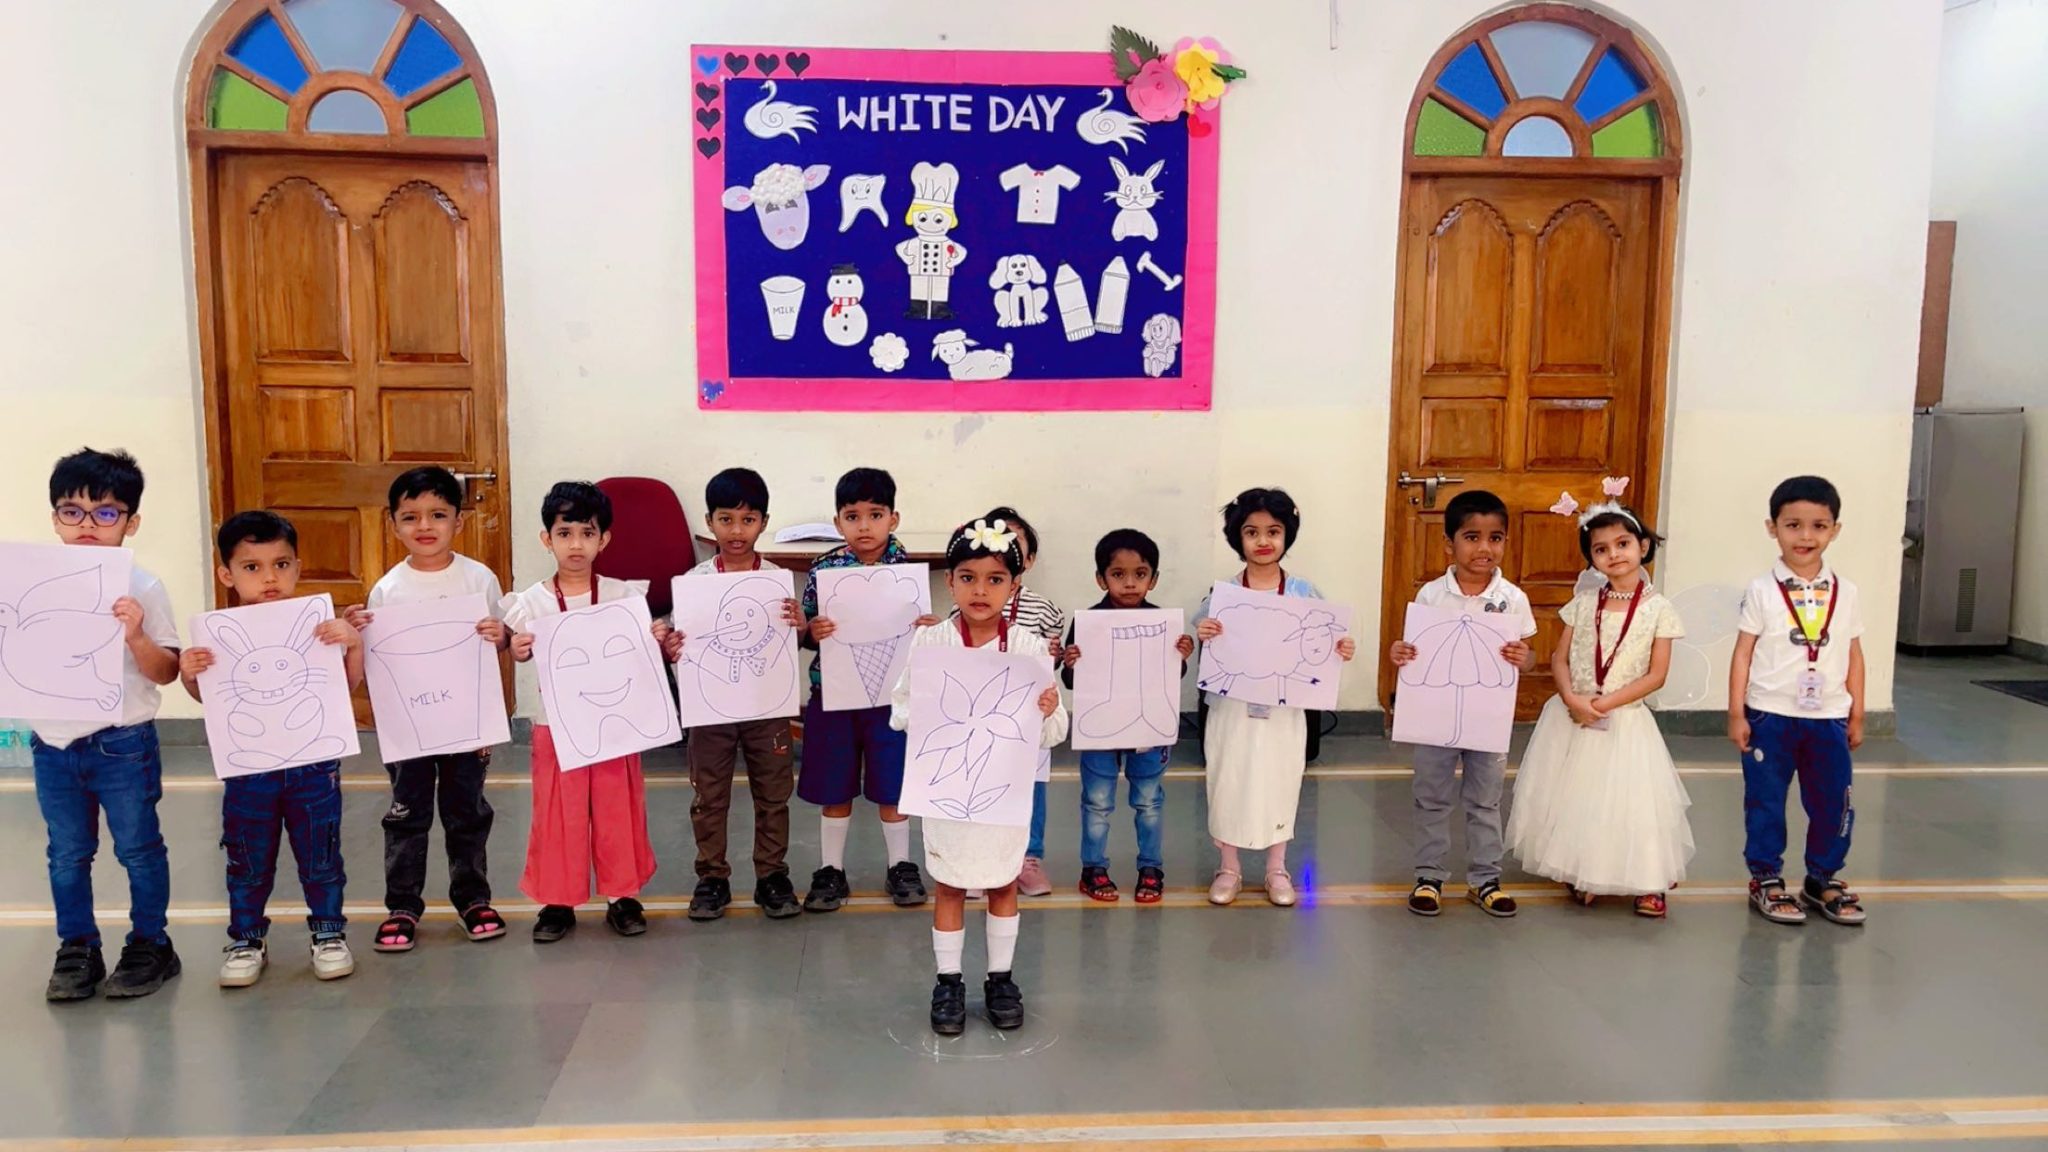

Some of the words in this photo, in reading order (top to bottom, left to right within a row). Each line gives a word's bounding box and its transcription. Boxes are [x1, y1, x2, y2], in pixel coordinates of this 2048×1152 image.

[837, 93, 973, 132] WHITE
[988, 93, 1066, 133] DAY
[772, 305, 796, 315] MILK
[409, 689, 454, 709] MILK
